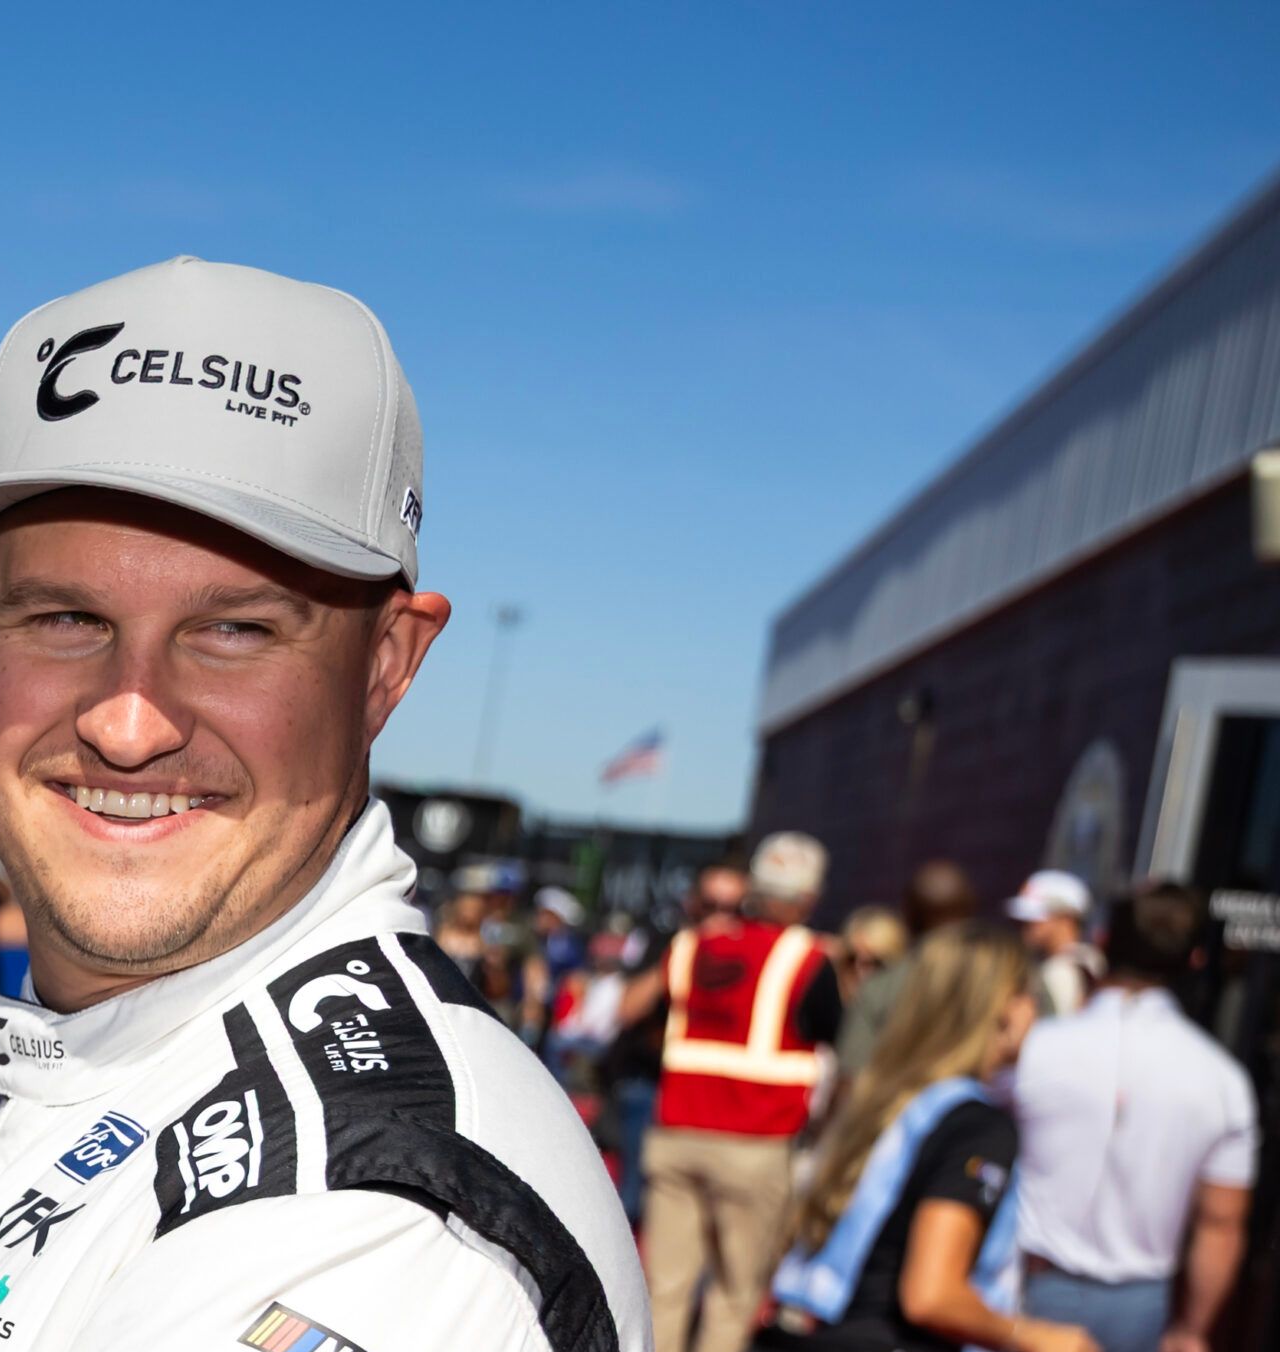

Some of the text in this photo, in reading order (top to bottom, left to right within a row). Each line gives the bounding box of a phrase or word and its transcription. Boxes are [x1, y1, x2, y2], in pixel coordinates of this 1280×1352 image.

[111, 349, 302, 408] CELSIUS
[225, 399, 267, 419] LIVE
[9, 1034, 65, 1059] CELSIUS
[191, 1100, 250, 1199] OMP
